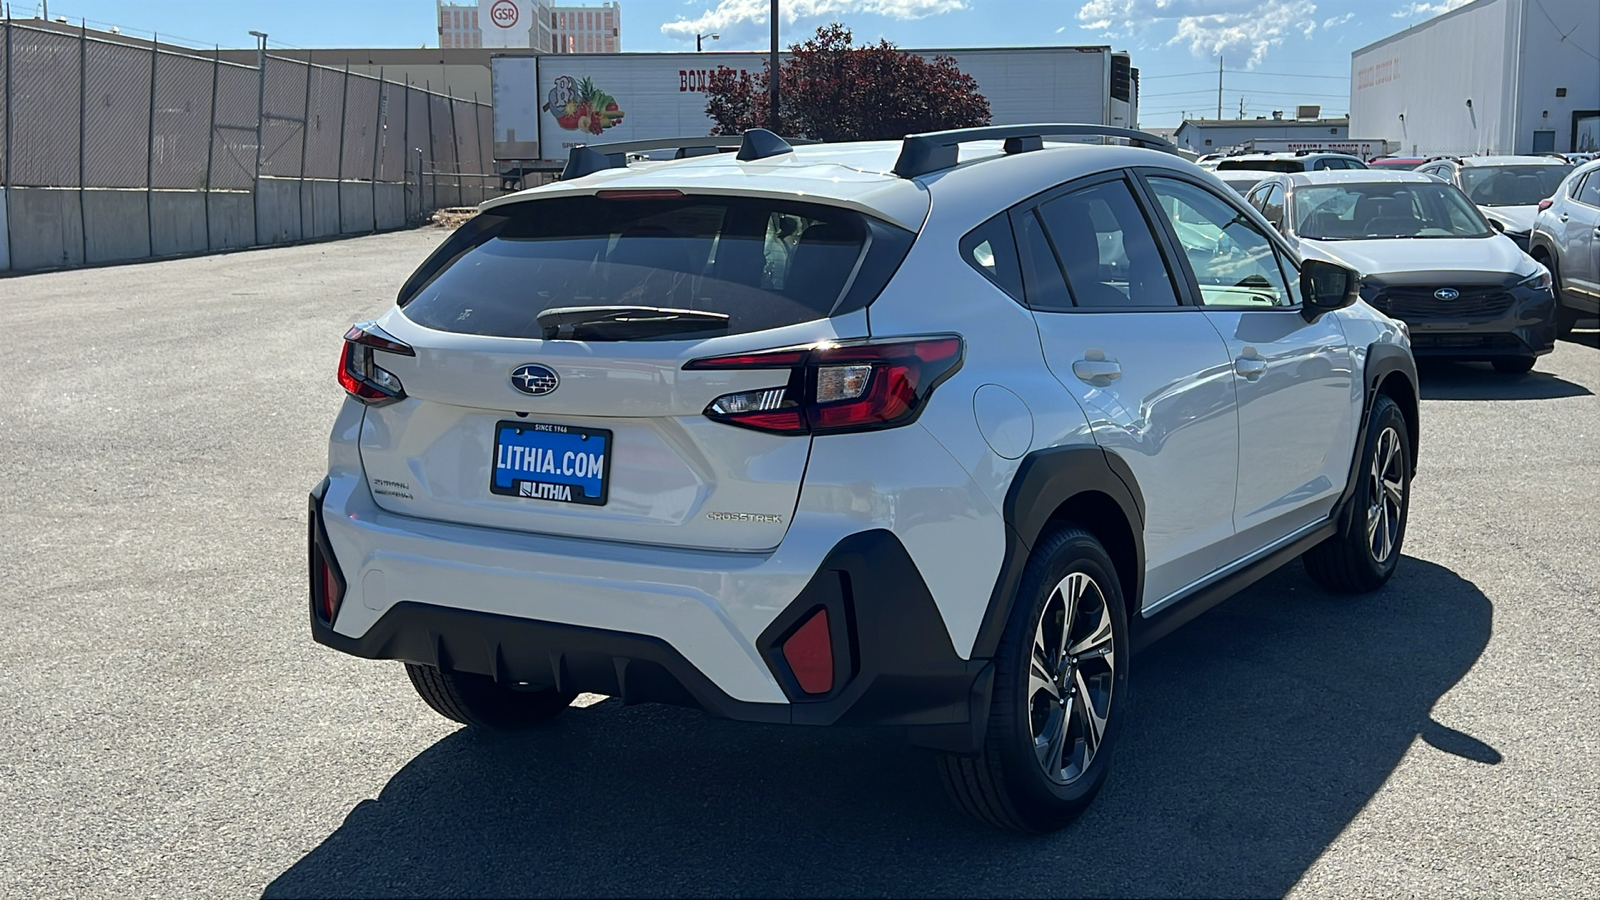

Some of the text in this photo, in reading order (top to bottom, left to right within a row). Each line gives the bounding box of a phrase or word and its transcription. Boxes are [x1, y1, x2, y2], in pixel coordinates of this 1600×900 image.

[494, 8, 515, 20] GSR
[534, 423, 568, 433] SINCE 1946
[497, 444, 604, 479] LITHIA.COM
[531, 482, 572, 501] LITHIA
[705, 511, 782, 523] CROSSTREK
